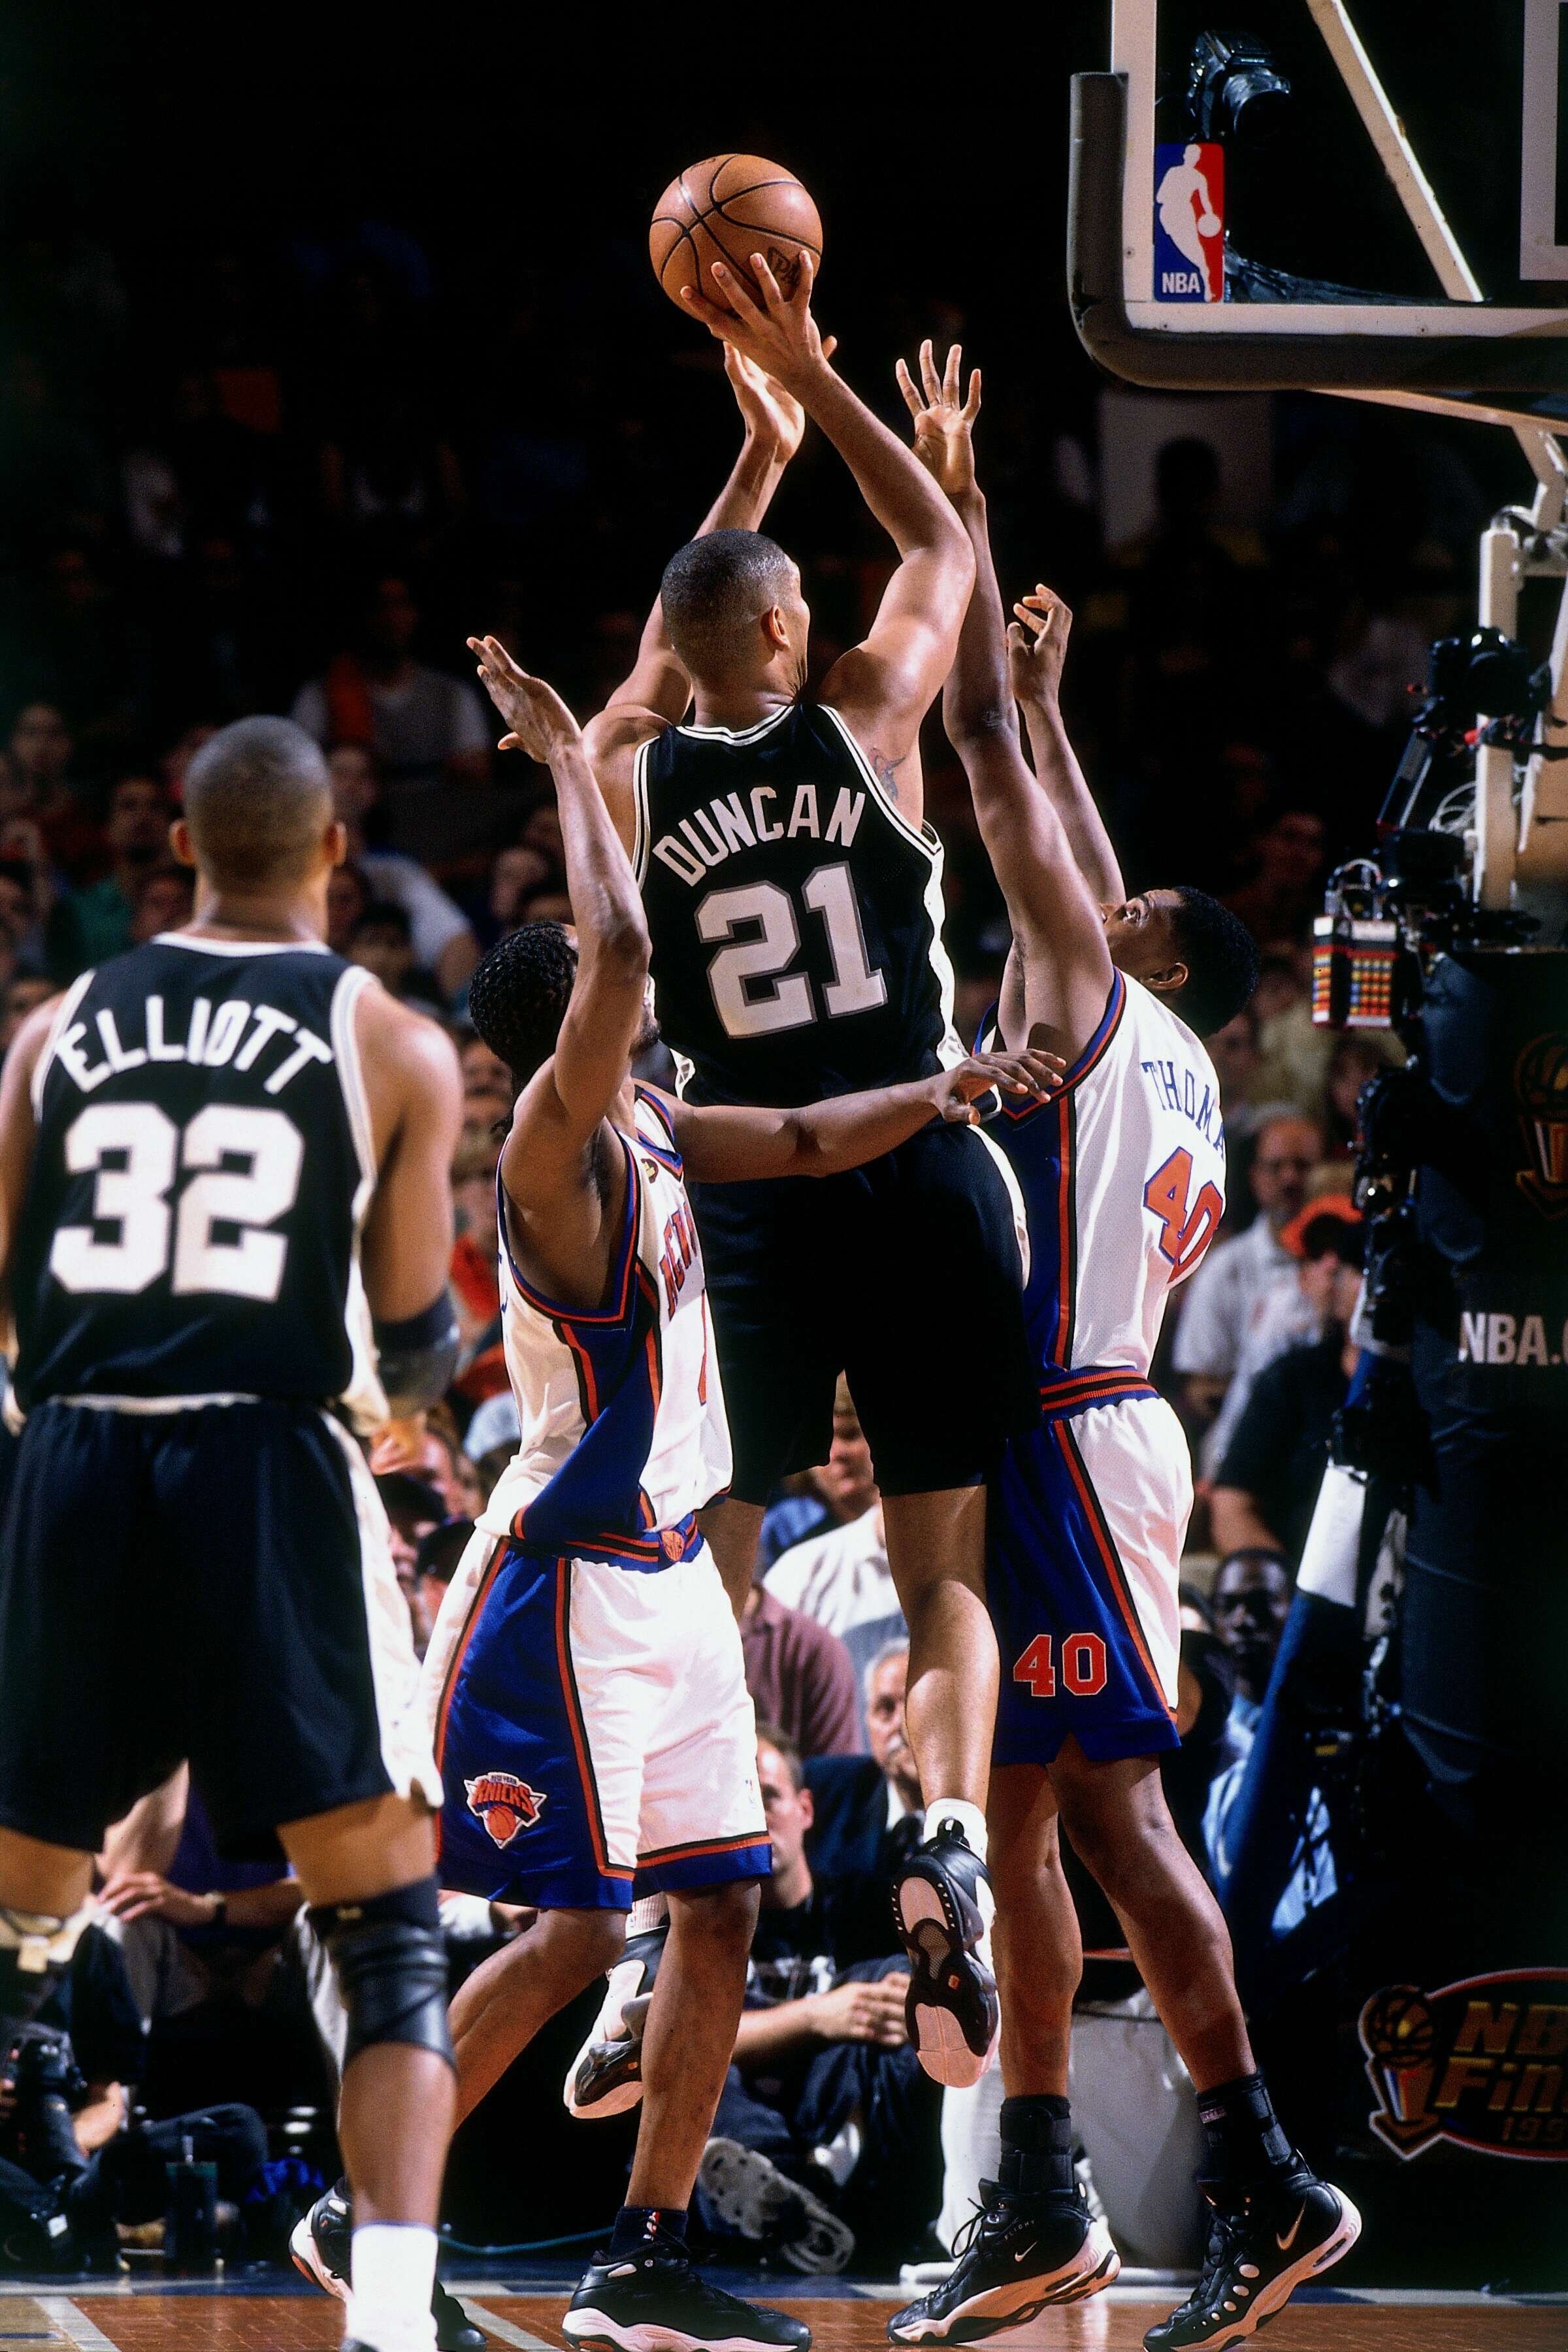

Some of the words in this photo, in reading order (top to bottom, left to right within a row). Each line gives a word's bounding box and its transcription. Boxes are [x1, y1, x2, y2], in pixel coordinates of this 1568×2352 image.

[1162, 272, 1200, 293] NBA
[652, 784, 865, 887] DUNCAN
[694, 860, 888, 1039] 21
[54, 994, 333, 1094] ELLIOTT
[50, 1100, 304, 1303] 32
[1143, 1146, 1223, 1283] 40
[1458, 1311, 1568, 1365] NBA.
[1013, 1633, 1107, 1697] 40
[472, 1778, 535, 1818] KNICKS
